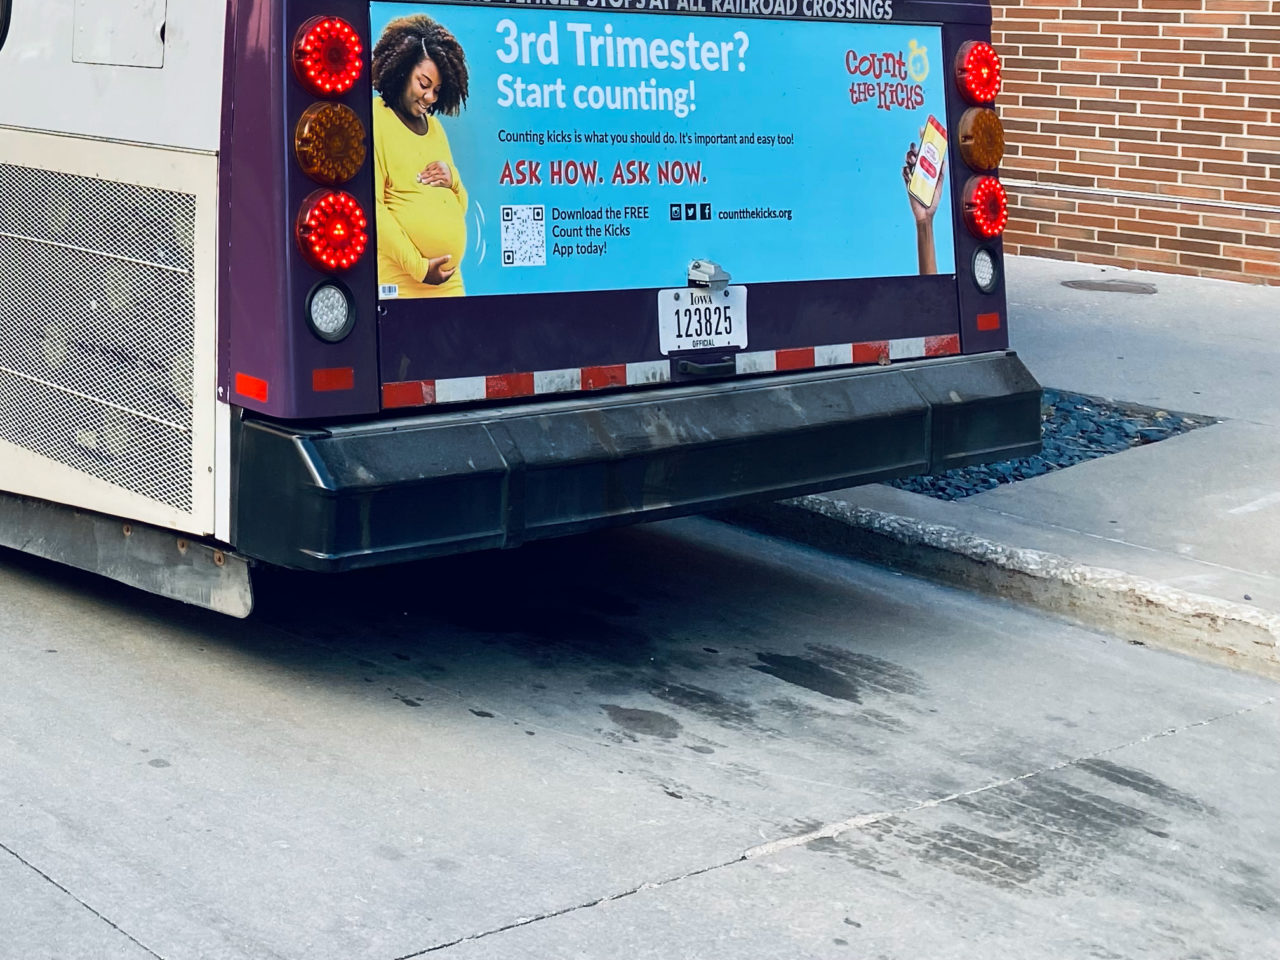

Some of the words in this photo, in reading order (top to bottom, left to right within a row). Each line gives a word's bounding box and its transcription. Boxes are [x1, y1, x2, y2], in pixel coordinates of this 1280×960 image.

[495, 18, 559, 66] 3rd
[567, 22, 750, 72] Trimester?
[497, 73, 567, 109] Start
[573, 78, 696, 118] counting!
[498, 129, 544, 146] Counting
[547, 130, 572, 144] kicks
[574, 131, 582, 144] is
[584, 131, 608, 144] what
[611, 135, 629, 147] you
[630, 131, 661, 145] should
[663, 131, 677, 145] do.
[679, 131, 693, 145] It's
[694, 131, 737, 147] important
[739, 132, 755, 145] and
[757, 136, 775, 148] easy
[777, 133, 794, 146] too!
[499, 159, 542, 186] ASK
[550, 159, 605, 186] HOW.
[611, 159, 650, 186] ASK
[657, 159, 708, 186] NOW.
[552, 206, 603, 221] Download
[605, 206, 621, 220] the
[624, 206, 649, 219] FREE
[718, 207, 793, 221] countthekicks.org
[552, 224, 583, 238] Count
[586, 224, 602, 237] the
[604, 223, 630, 237] Kicks
[552, 243, 574, 257] App
[576, 242, 607, 257] today!
[675, 306, 732, 338] 123825
[692, 339, 715, 348] OFFICIAL
